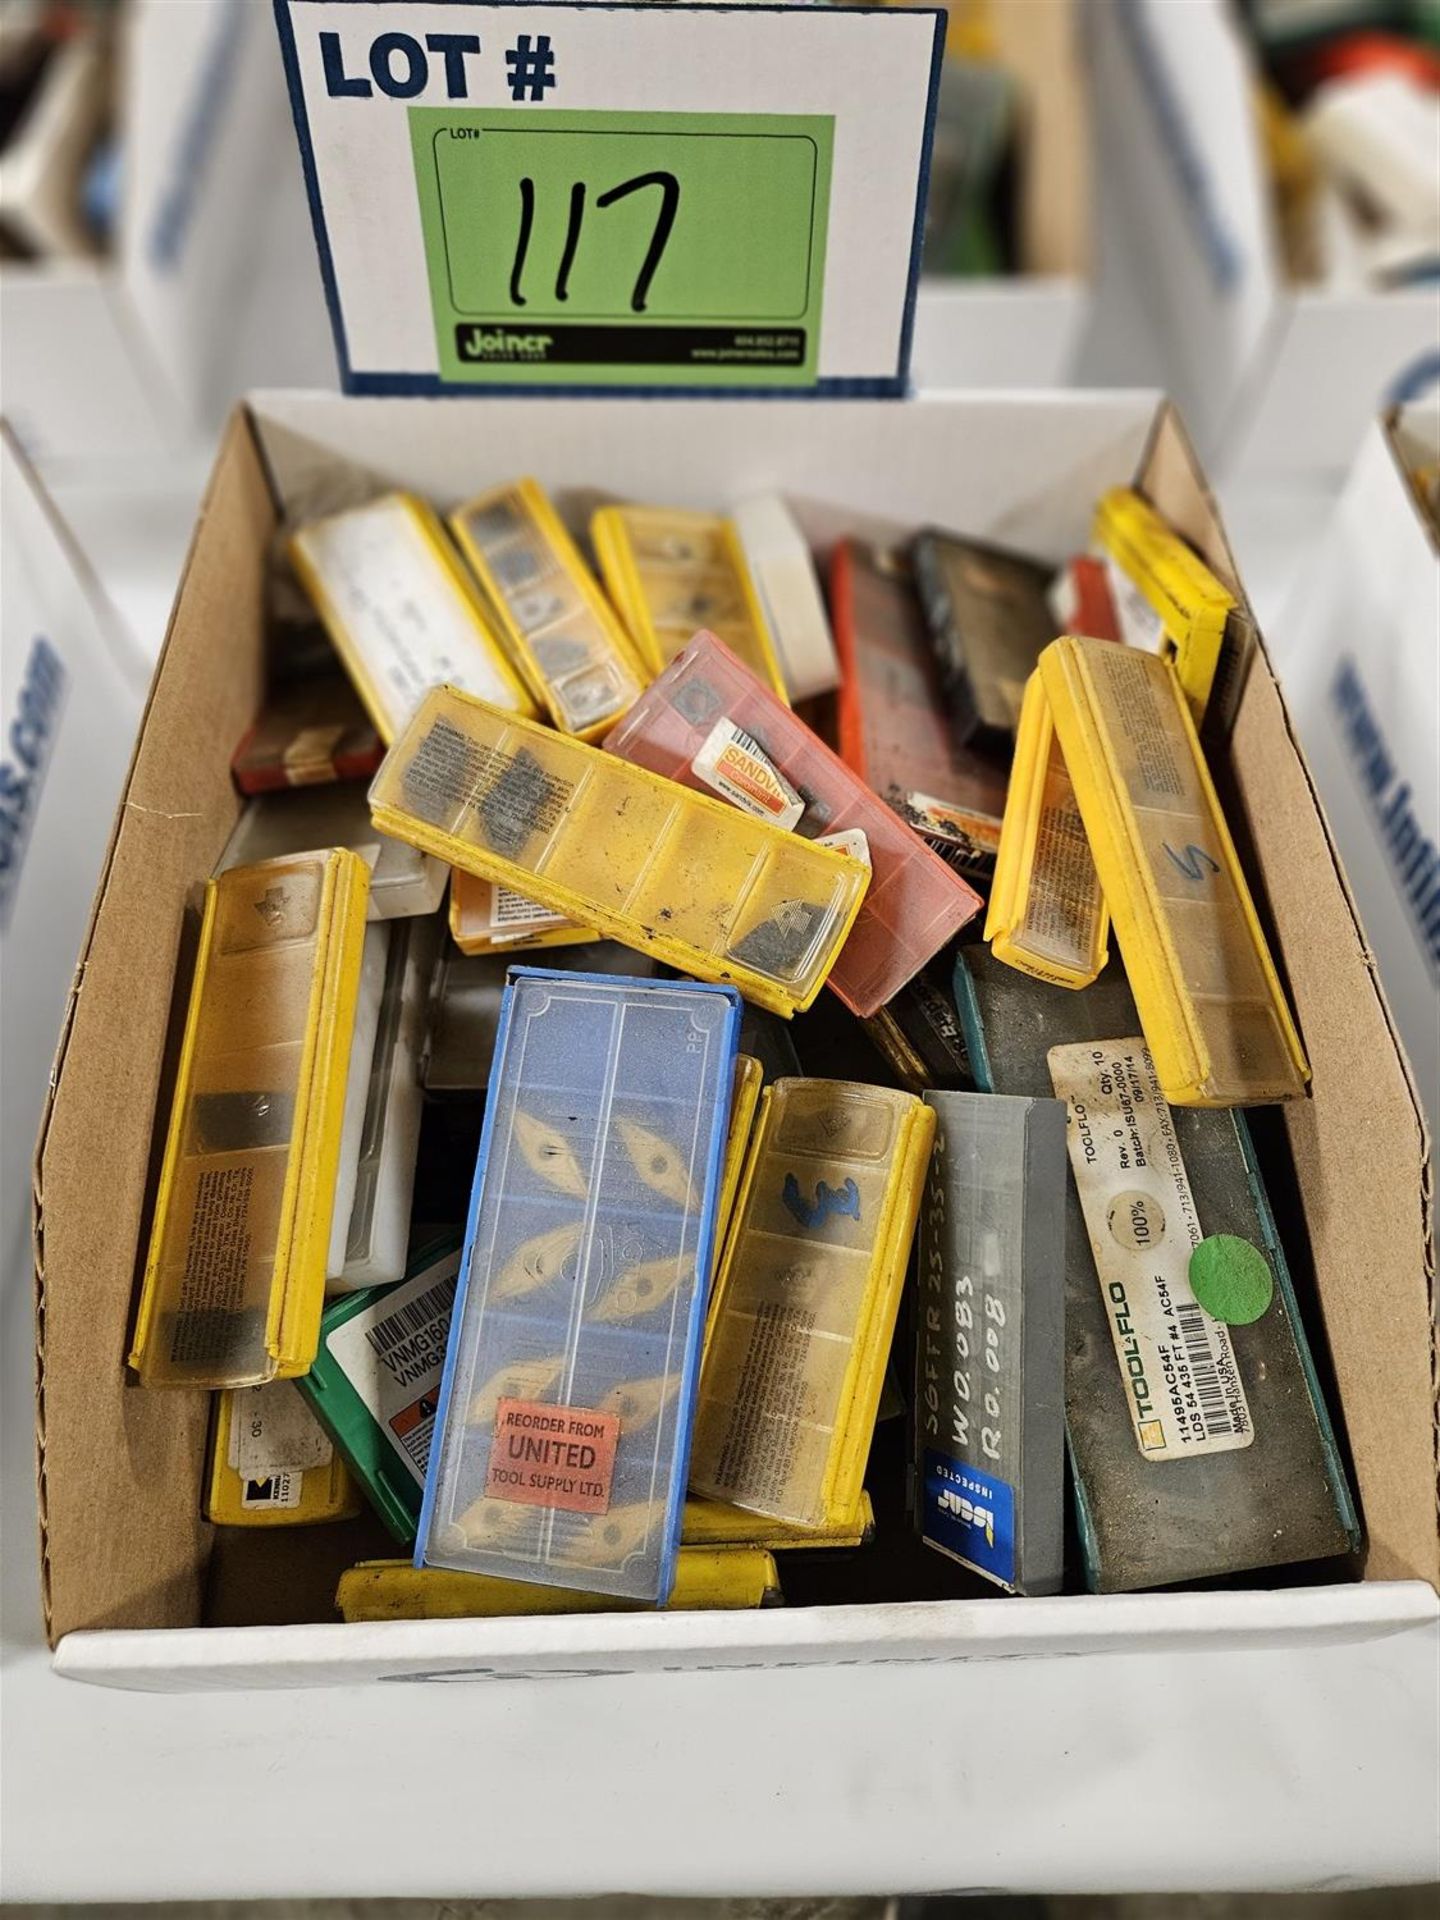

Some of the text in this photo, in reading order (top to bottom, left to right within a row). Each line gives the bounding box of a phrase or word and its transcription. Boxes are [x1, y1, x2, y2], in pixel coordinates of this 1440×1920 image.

[319, 32, 556, 100] LOT #
[450, 127, 481, 140] LOT#
[510, 170, 680, 312] 117
[1092, 1051, 1113, 1095] Qty. 10
[1124, 1056, 1145, 1103] 09/17/14
[1119, 1142, 1131, 1169] Rev.
[1131, 1200, 1151, 1246] 100%
[383, 1317, 451, 1374] VNMG160
[393, 1347, 447, 1388] VNMG3
[1154, 1274, 1205, 1441] LDS 54 435 FT #4 AC54F
[981, 1293, 1006, 1460] R 0.008
[1158, 1343, 1191, 1443] 11495AC54F
[506, 1412, 605, 1439] REORDER FROM
[508, 1434, 596, 1470] UNITED
[492, 1468, 606, 1498] TOOL SUPPLY LTD.
[936, 1465, 993, 1500] INSPECTED
